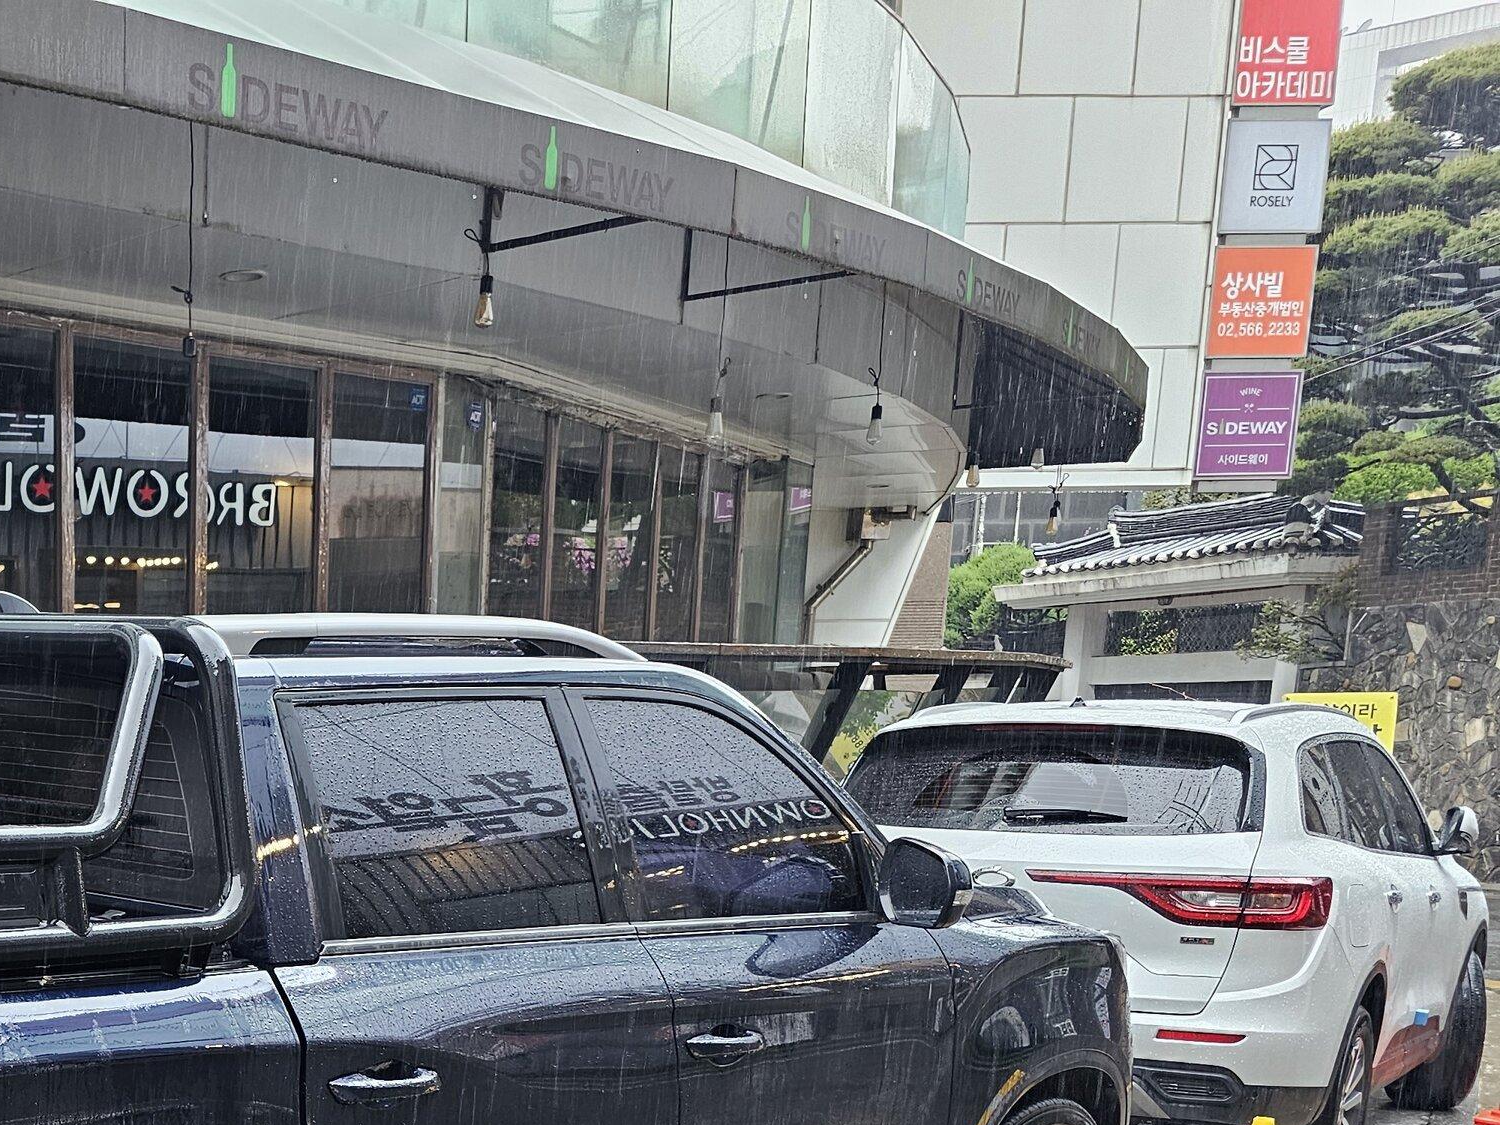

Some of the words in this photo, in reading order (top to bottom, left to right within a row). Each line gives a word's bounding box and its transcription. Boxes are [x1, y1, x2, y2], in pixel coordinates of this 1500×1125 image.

[1240, 36, 1310, 64] 비스쿨
[1236, 70, 1334, 99] 아카데미
[1249, 195, 1294, 207] ROSELY
[1221, 272, 1285, 299] 상사빌
[1218, 301, 1304, 317] 부동산중개법인
[1217, 322, 1301, 338] 02.566.2233
[1240, 387, 1263, 397] WINE
[1206, 418, 1288, 436] SIDEWAY
[1217, 453, 1269, 465] 사이드웨이
